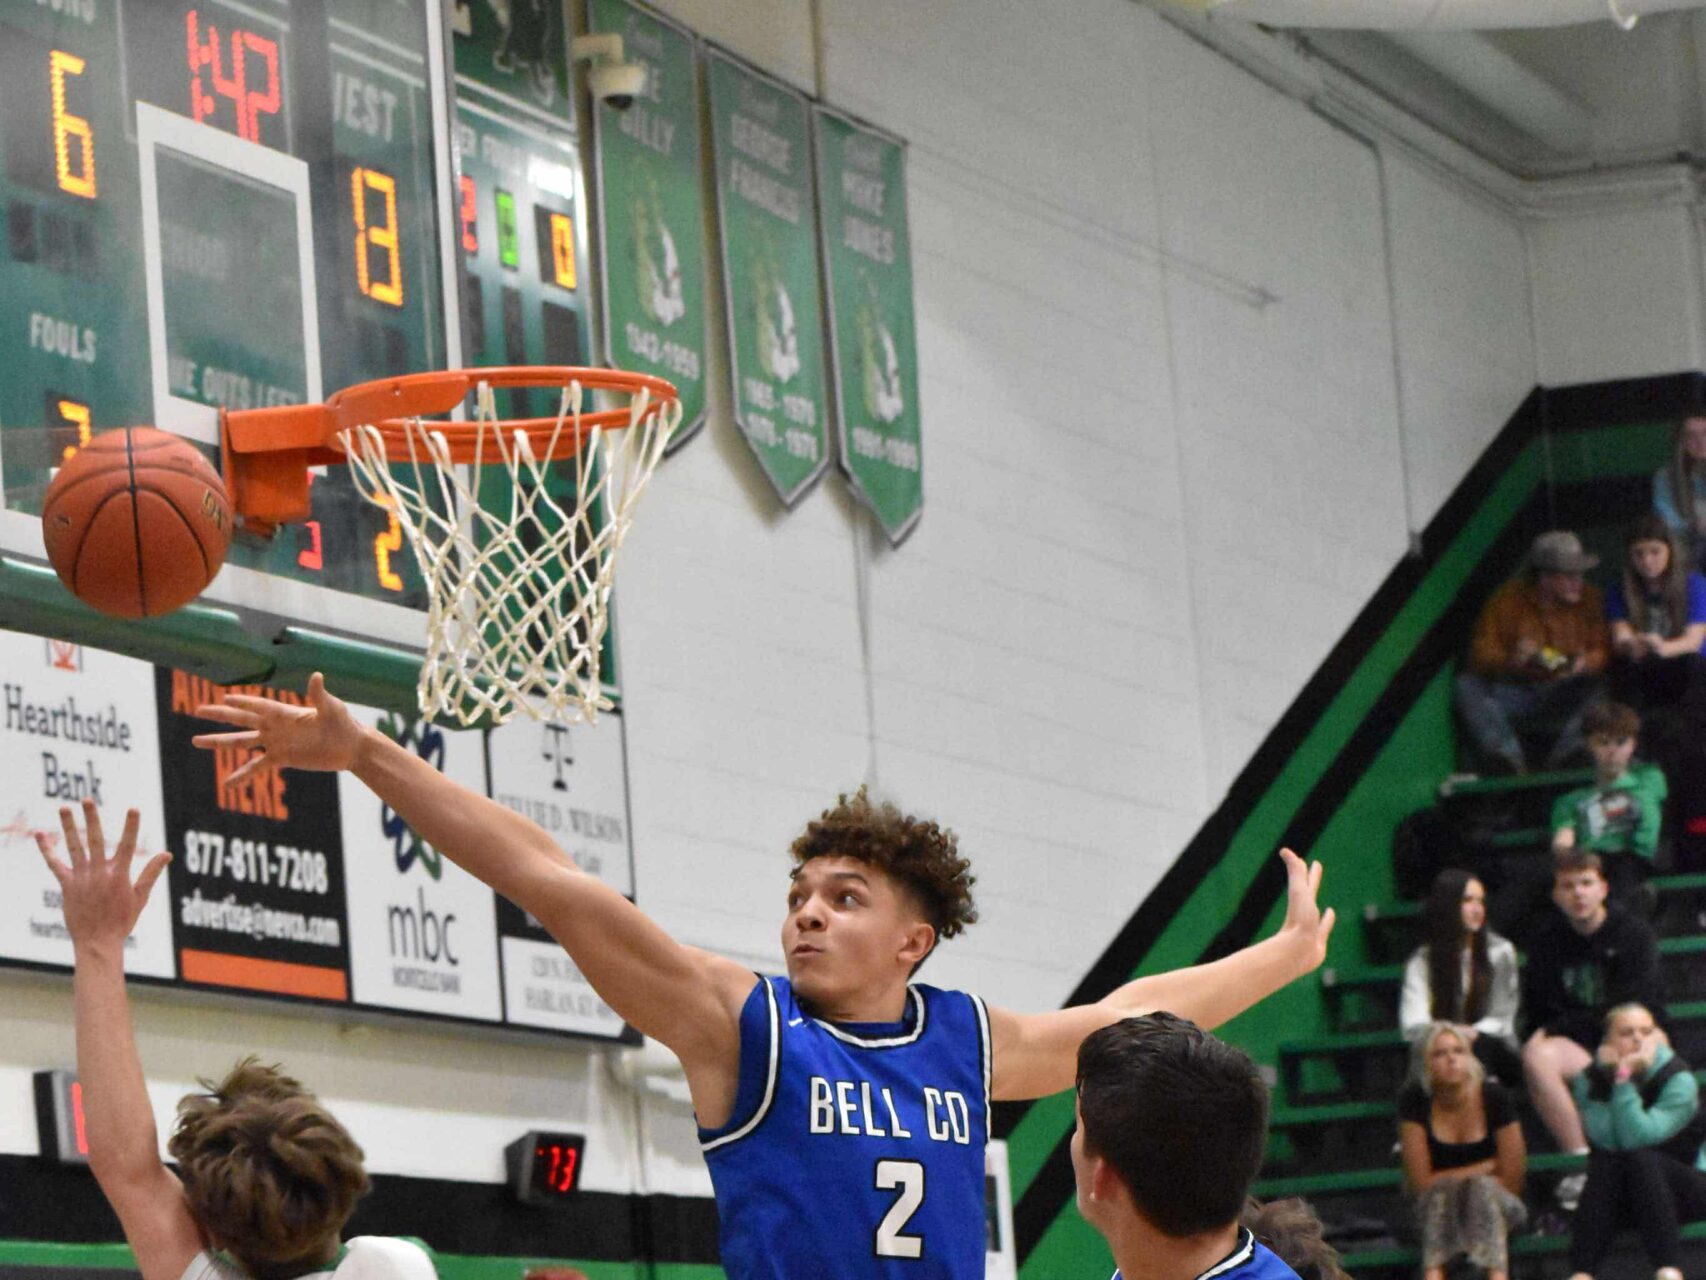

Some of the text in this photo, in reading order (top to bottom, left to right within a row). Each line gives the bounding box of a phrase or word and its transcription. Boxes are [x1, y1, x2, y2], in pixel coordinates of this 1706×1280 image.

[50, 49, 96, 199] 6
[30, 312, 96, 364] FOULS
[374, 491, 403, 591] 2
[4, 683, 131, 751] Hearthside
[42, 752, 102, 806] Bank
[185, 829, 328, 895] 877-811-7208
[388, 886, 459, 967] mbc
[810, 1075, 970, 1145] BELL CO
[876, 1160, 925, 1259] 2
